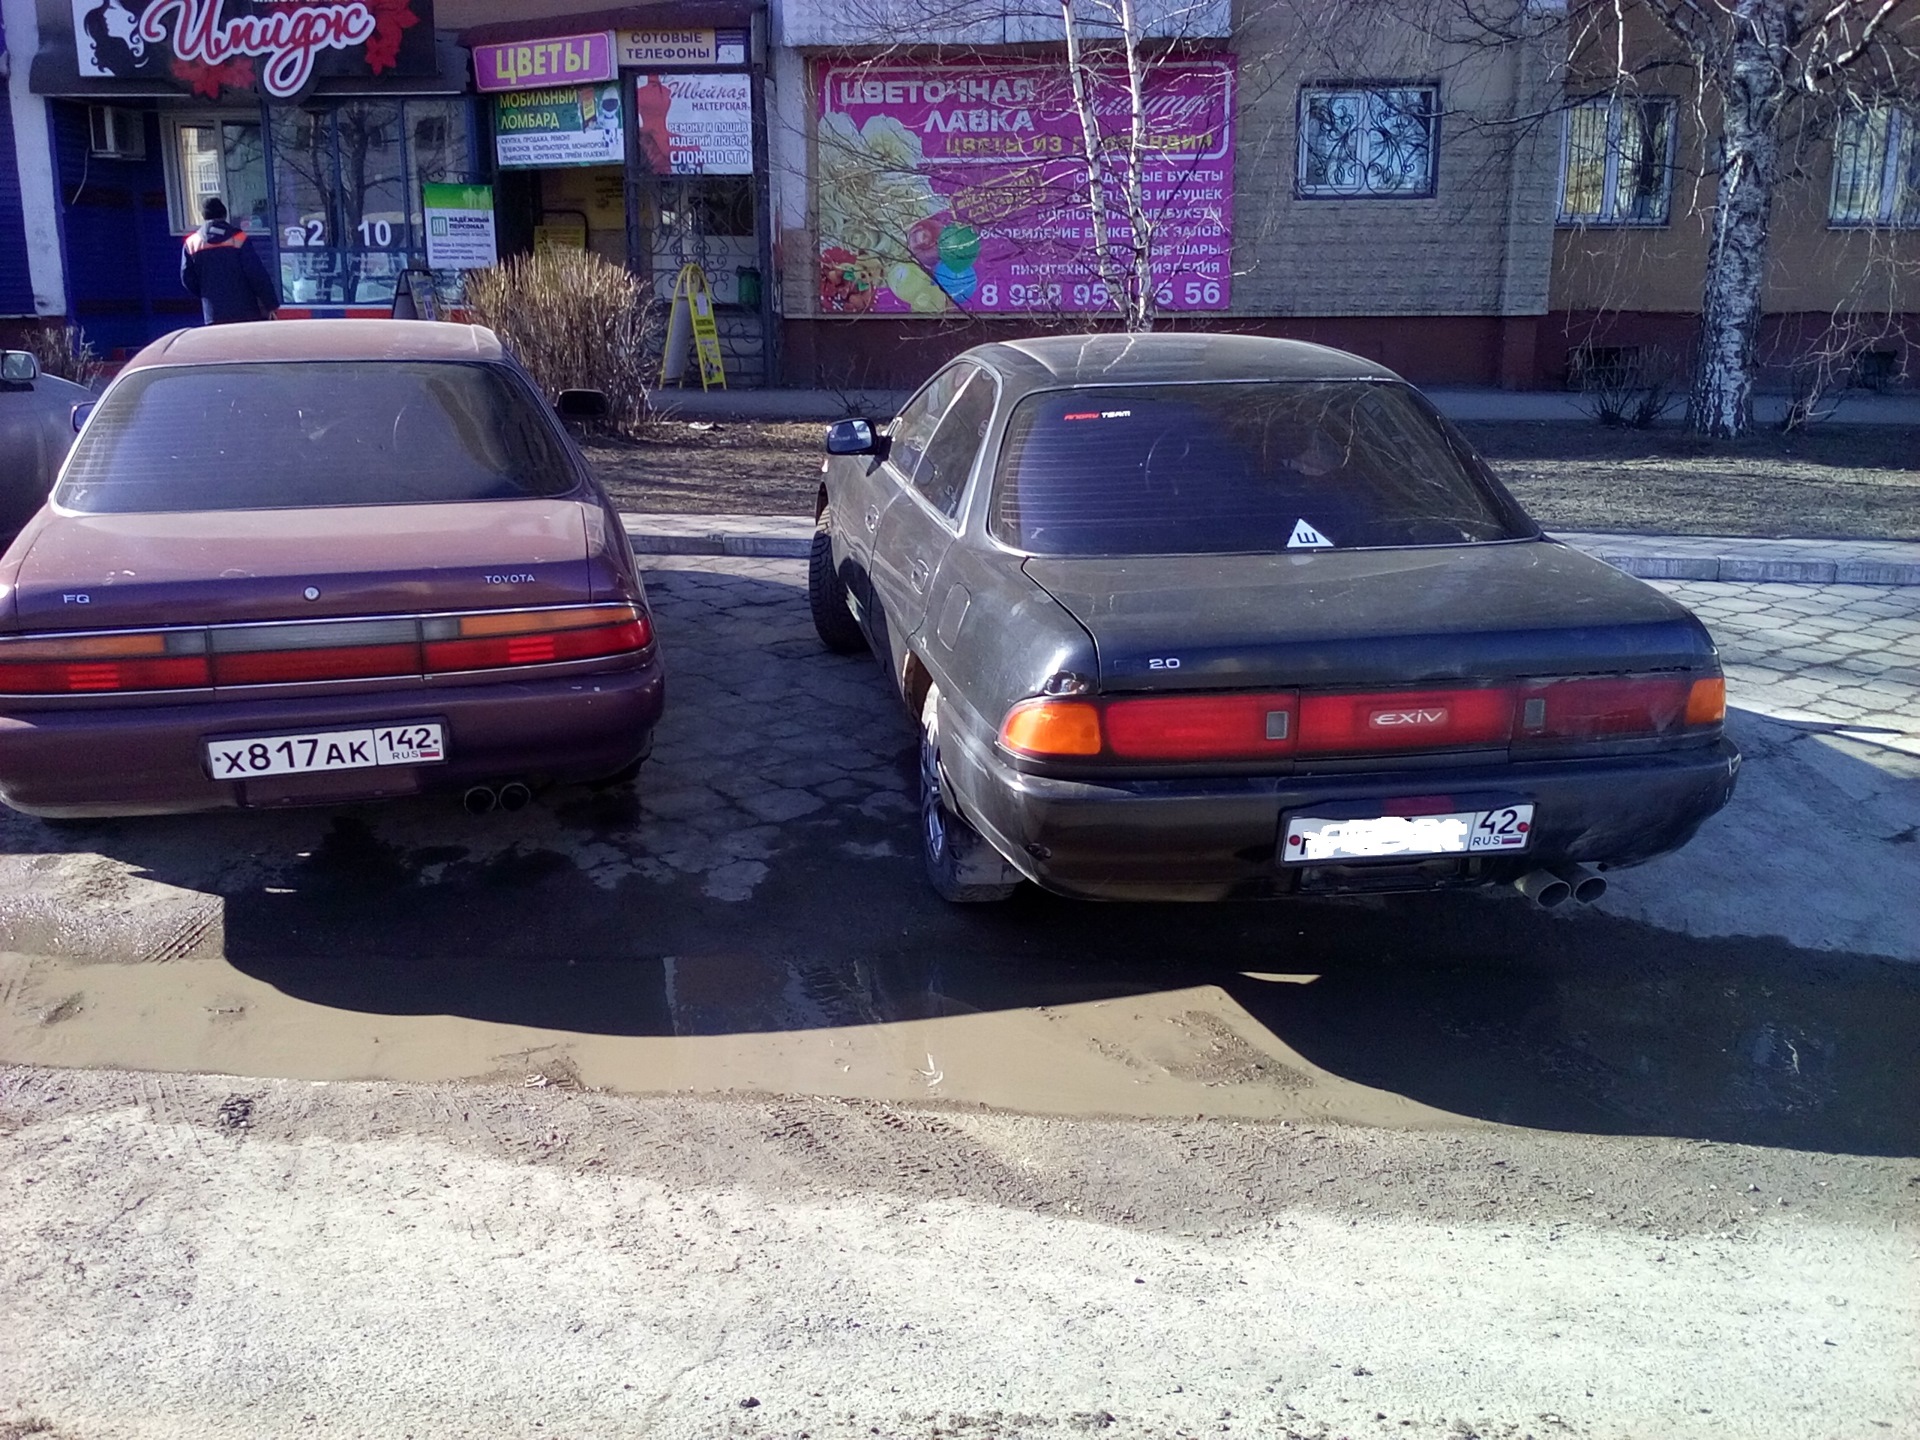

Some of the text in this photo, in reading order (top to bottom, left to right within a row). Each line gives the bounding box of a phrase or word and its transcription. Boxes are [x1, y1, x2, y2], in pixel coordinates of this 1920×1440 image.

[631, 31, 703, 44] СОТОВЫЕ
[140, 0, 374, 97] Имидж
[626, 47, 710, 59] ТЕЛЕФОНЫ
[496, 40, 591, 84] ЦВЕТЫ
[500, 87, 578, 109] МОБИЛЬНЫЙ
[668, 81, 747, 100] Швейная
[840, 79, 1035, 105] ЦВЕТОЧНАЯ
[692, 102, 747, 111] МАСТЕРСКАЯ
[501, 112, 560, 130] ЛОМБАРД
[668, 122, 749, 133] РЕМОНТ И ПОШИВ
[923, 109, 1035, 133] ЛАВКА
[668, 135, 749, 148] ИЗДЕЛИЙ ЛЮБОЙ
[947, 137, 1023, 155] ЦВЕТЫ
[1033, 136, 1063, 151] ИЗ
[669, 150, 749, 165] СЛОЖНОСТИ
[1167, 170, 1223, 183] БУКЕТЫ
[1155, 188, 1223, 201] ИГРУШЕК
[307, 220, 325, 246] 2
[358, 220, 391, 246] 10
[1176, 243, 1220, 256] ШАРЫ
[981, 284, 998, 306] 8
[1184, 281, 1221, 305] 56
[1296, 532, 1318, 543] Ш
[485, 574, 536, 584] TOYOTA
[379, 728, 432, 751] 142
[392, 749, 419, 760] RUS
[1480, 809, 1518, 834] 42
[1472, 834, 1501, 846] RUS
